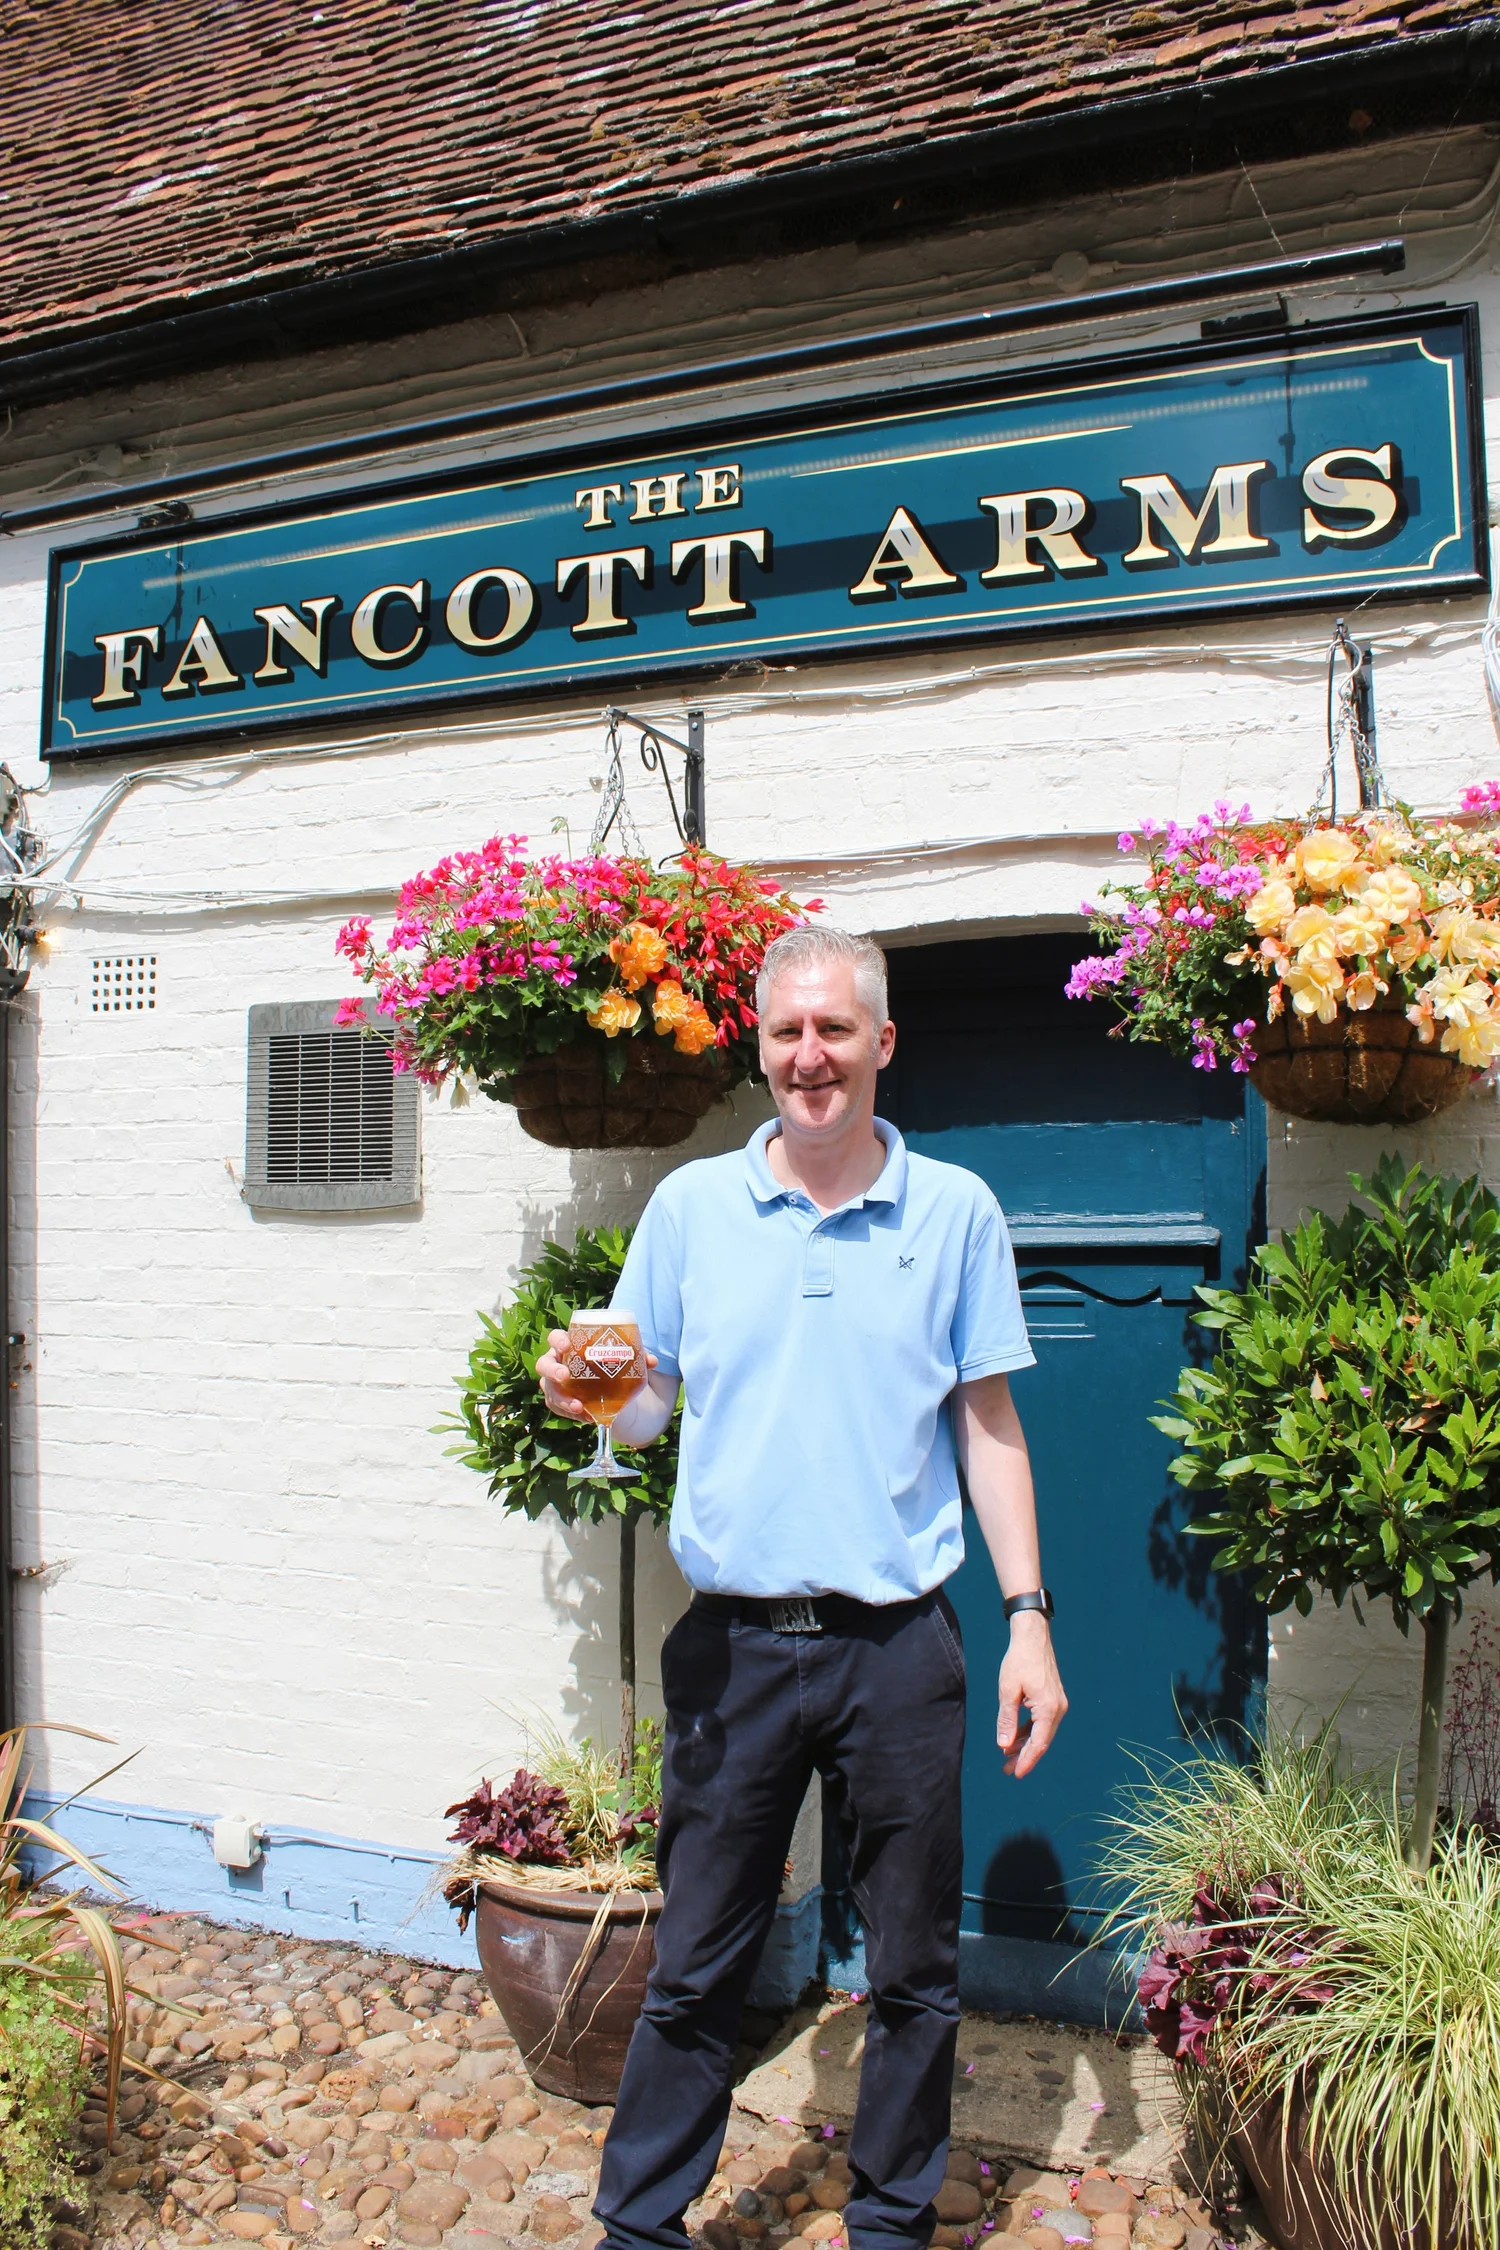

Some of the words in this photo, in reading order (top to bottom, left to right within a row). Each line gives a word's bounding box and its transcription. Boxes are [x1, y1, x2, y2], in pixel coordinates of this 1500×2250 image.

[575, 463, 743, 529] THE
[91, 528, 770, 706] FANCOTT
[848, 442, 1401, 600] ARMS
[589, 1348, 632, 1357] Cruzcampo
